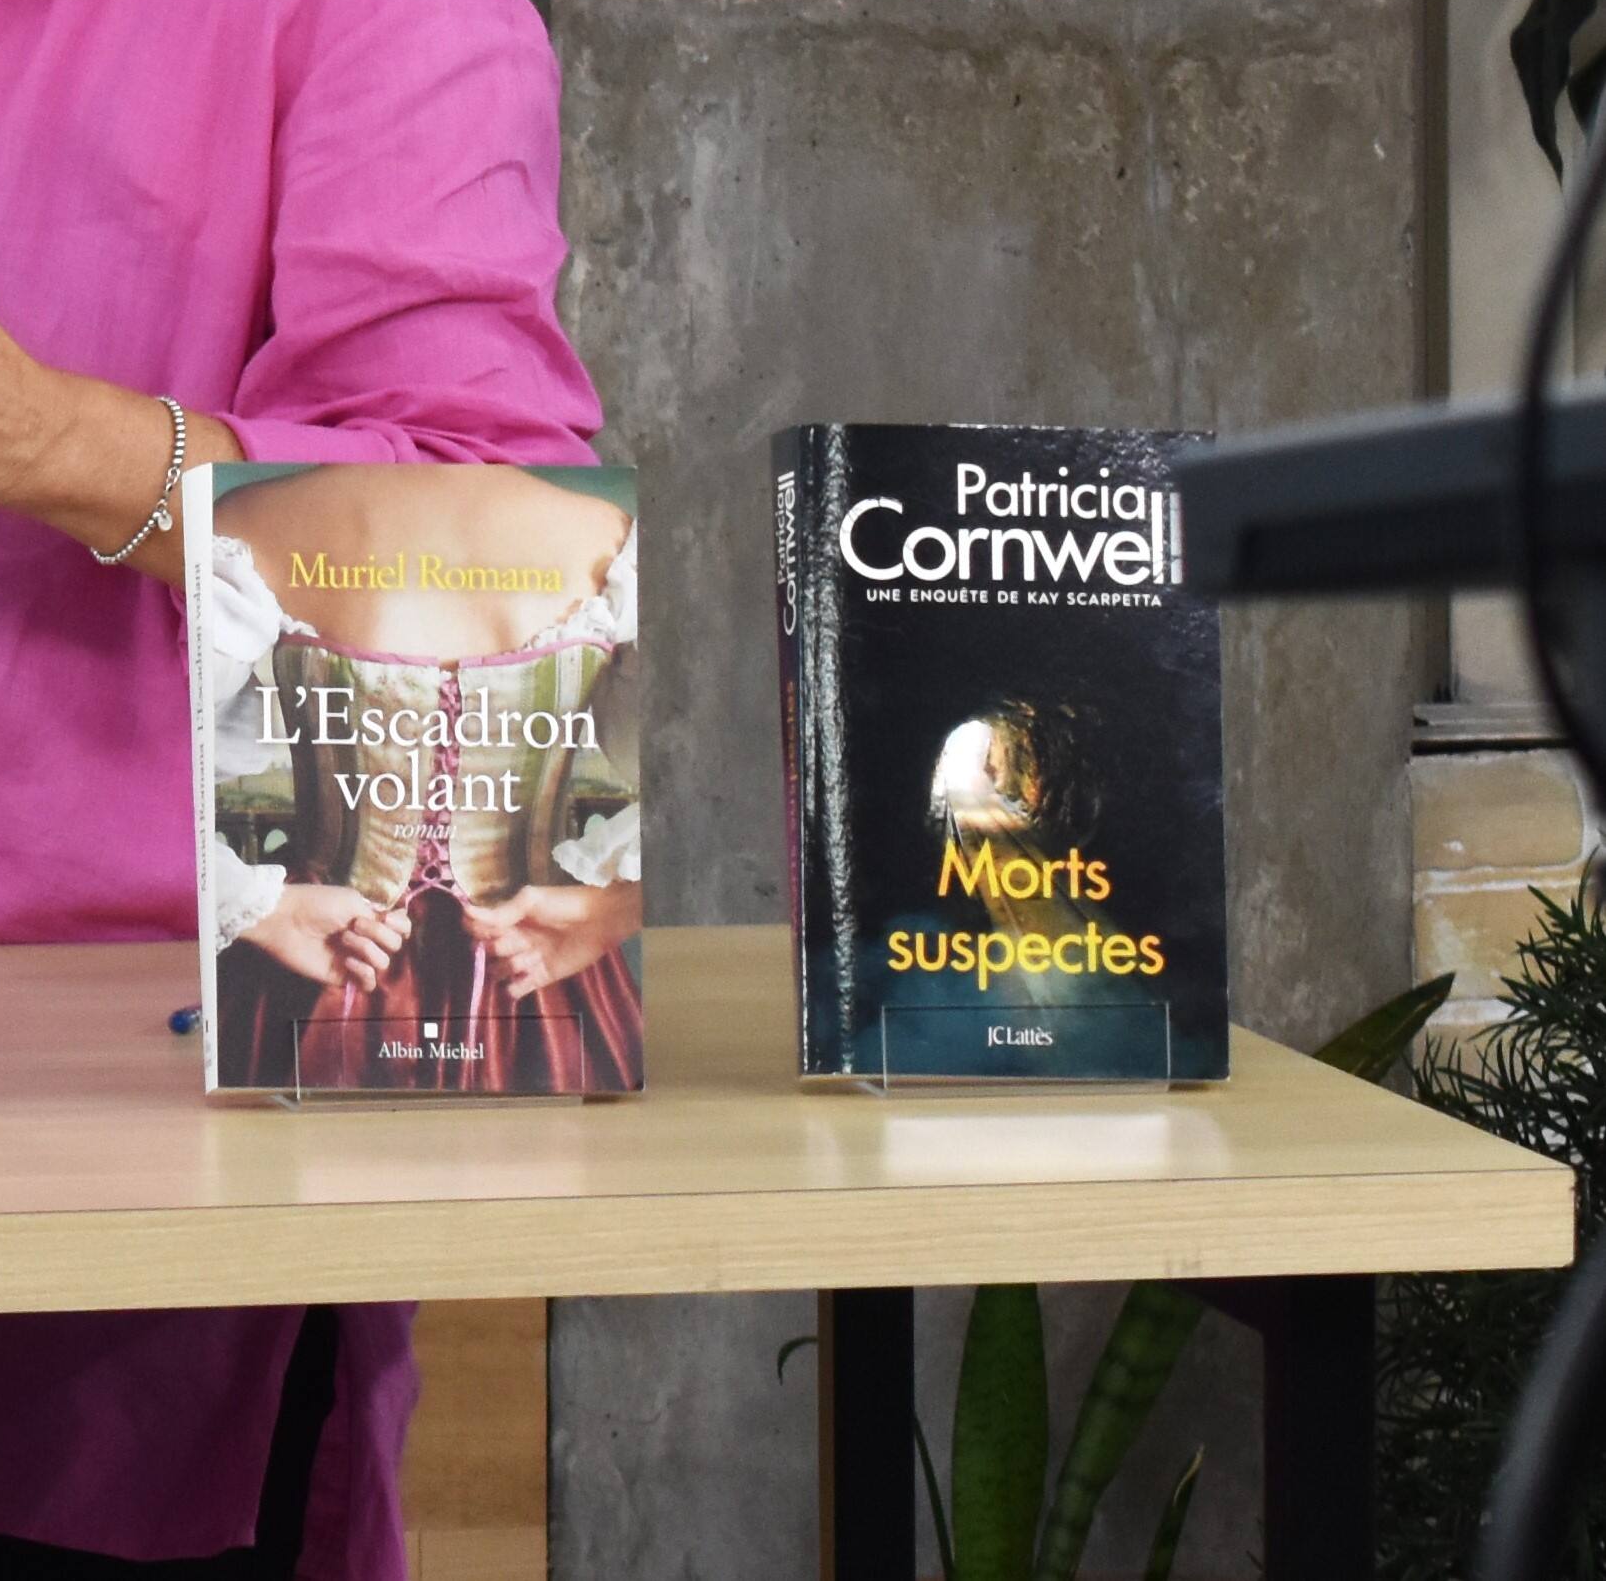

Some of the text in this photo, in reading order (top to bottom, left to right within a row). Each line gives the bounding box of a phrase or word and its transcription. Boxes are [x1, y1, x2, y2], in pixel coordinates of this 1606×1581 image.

[956, 462, 1146, 519] Patricia
[776, 490, 786, 586] Patricia
[778, 470, 796, 636] Cornwell
[838, 496, 1183, 586] Cornwell
[288, 552, 564, 593] Muriel Romana
[866, 587, 1163, 607] UNE ENQUÊTE DE KAY SCARPETTA
[255, 686, 599, 749] L’Escadron
[334, 750, 522, 812] volant
[393, 822, 457, 840] roman
[937, 838, 1111, 900] Morts
[888, 922, 1164, 990] suspectes
[378, 1041, 484, 1059] Albin Michel
[988, 1026, 1053, 1045] JC Lattès
